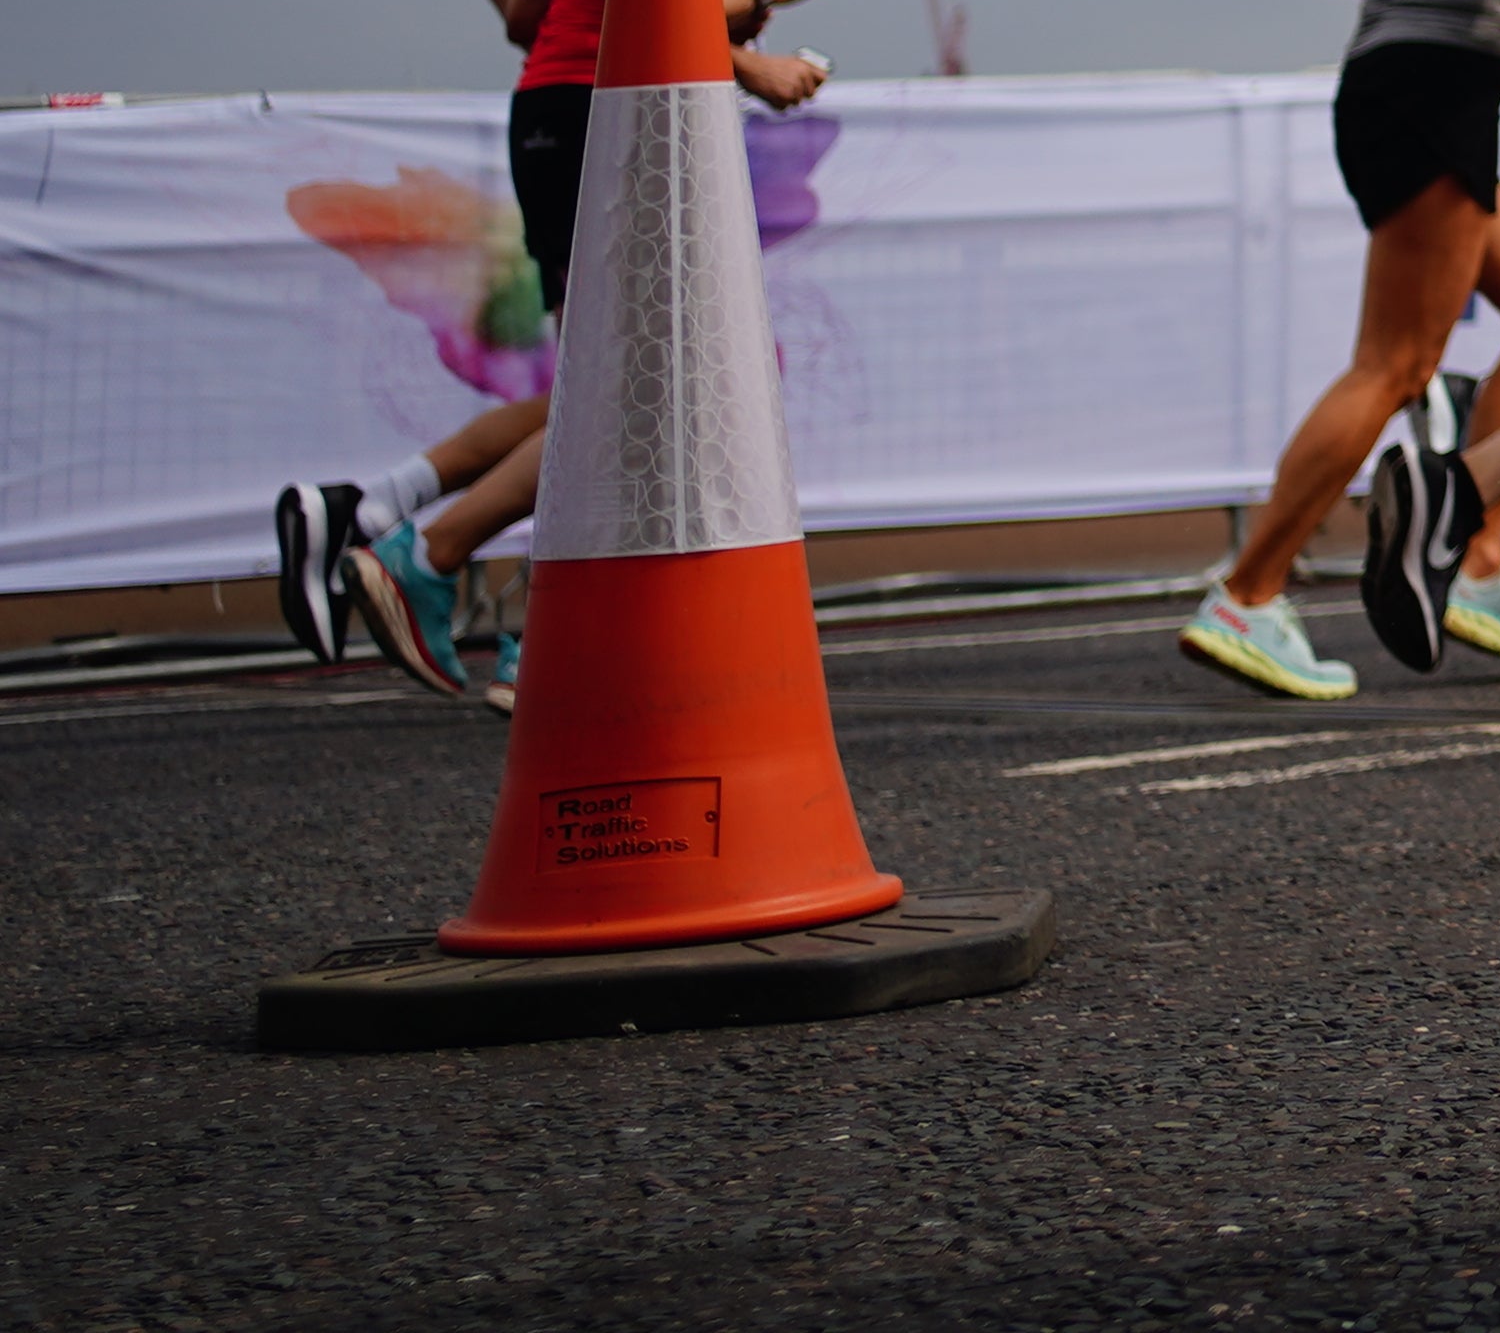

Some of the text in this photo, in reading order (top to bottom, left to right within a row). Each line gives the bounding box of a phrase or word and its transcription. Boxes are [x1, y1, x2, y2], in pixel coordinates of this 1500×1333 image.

[557, 793, 632, 819] Road
[557, 814, 649, 841] Traffic
[556, 836, 690, 865] Solutions
